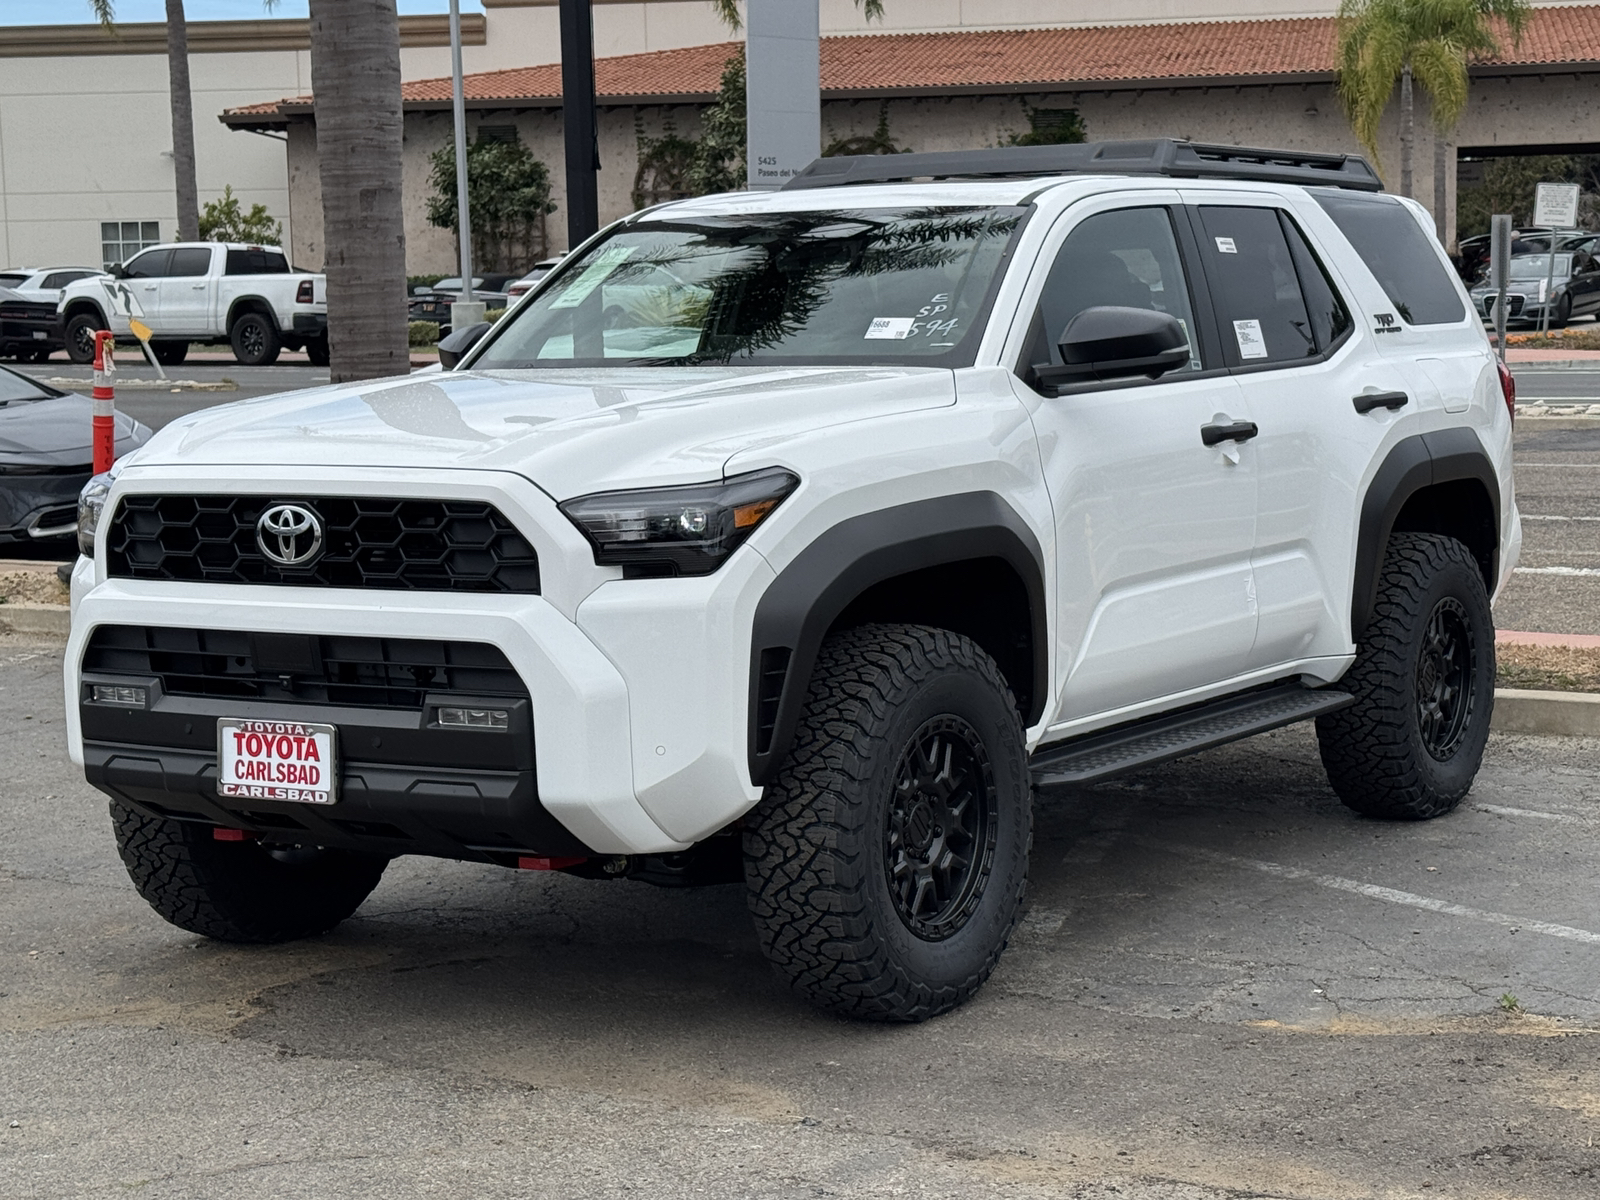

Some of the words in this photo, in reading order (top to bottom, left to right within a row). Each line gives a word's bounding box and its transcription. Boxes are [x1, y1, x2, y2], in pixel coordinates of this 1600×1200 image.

[758, 168, 778, 177] Paseo
[779, 168, 791, 177] del
[931, 293, 949, 303] E
[245, 722, 305, 735] TOYOTA
[233, 732, 321, 762] TOYOTA
[234, 759, 321, 785] CARLSBAD
[223, 784, 329, 803] CARLSBAD
